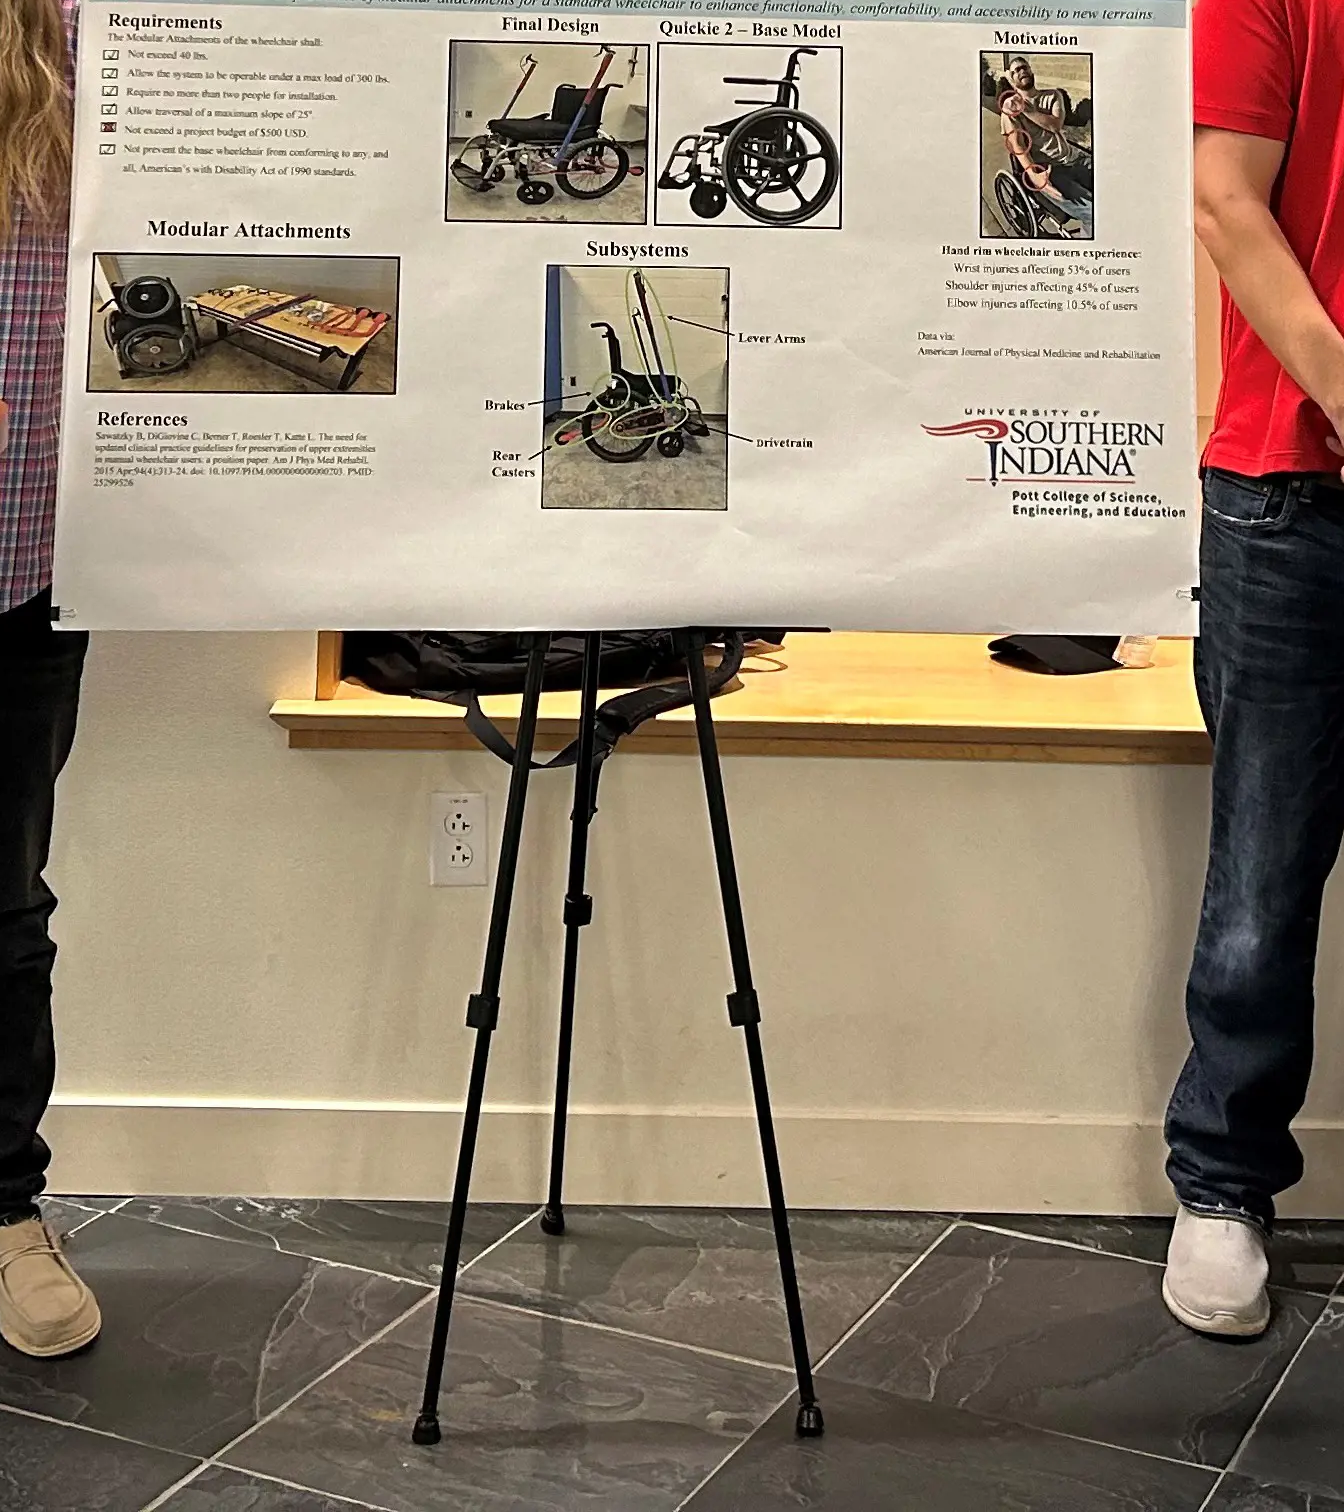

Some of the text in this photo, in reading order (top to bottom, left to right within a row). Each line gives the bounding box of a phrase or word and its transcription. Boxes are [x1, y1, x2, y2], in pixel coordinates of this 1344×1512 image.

[108, 12, 223, 31] Requirements
[502, 16, 599, 36] Final Design
[994, 30, 1078, 46] Motivation
[127, 49, 208, 61] Not exceed 40 lbs.
[146, 219, 351, 239] Modular Attachments
[586, 240, 689, 262] Subsystems
[941, 245, 1141, 260] Hand rim wheelchair users experience:
[953, 262, 1131, 277] Wrist injuries affecting 53% of users
[738, 332, 806, 344] Lever Arms
[484, 399, 525, 411] Brakes
[964, 407, 1100, 418] UNIVERSITY OF
[96, 411, 188, 427] References
[1009, 419, 1165, 447] SOUTHERN
[756, 436, 813, 449] Drivetrain
[492, 450, 522, 462] Rear
[490, 466, 536, 478] Casters
[1011, 489, 1162, 506] Pott College of Science,
[1012, 503, 1186, 519] Engineering, and Education
